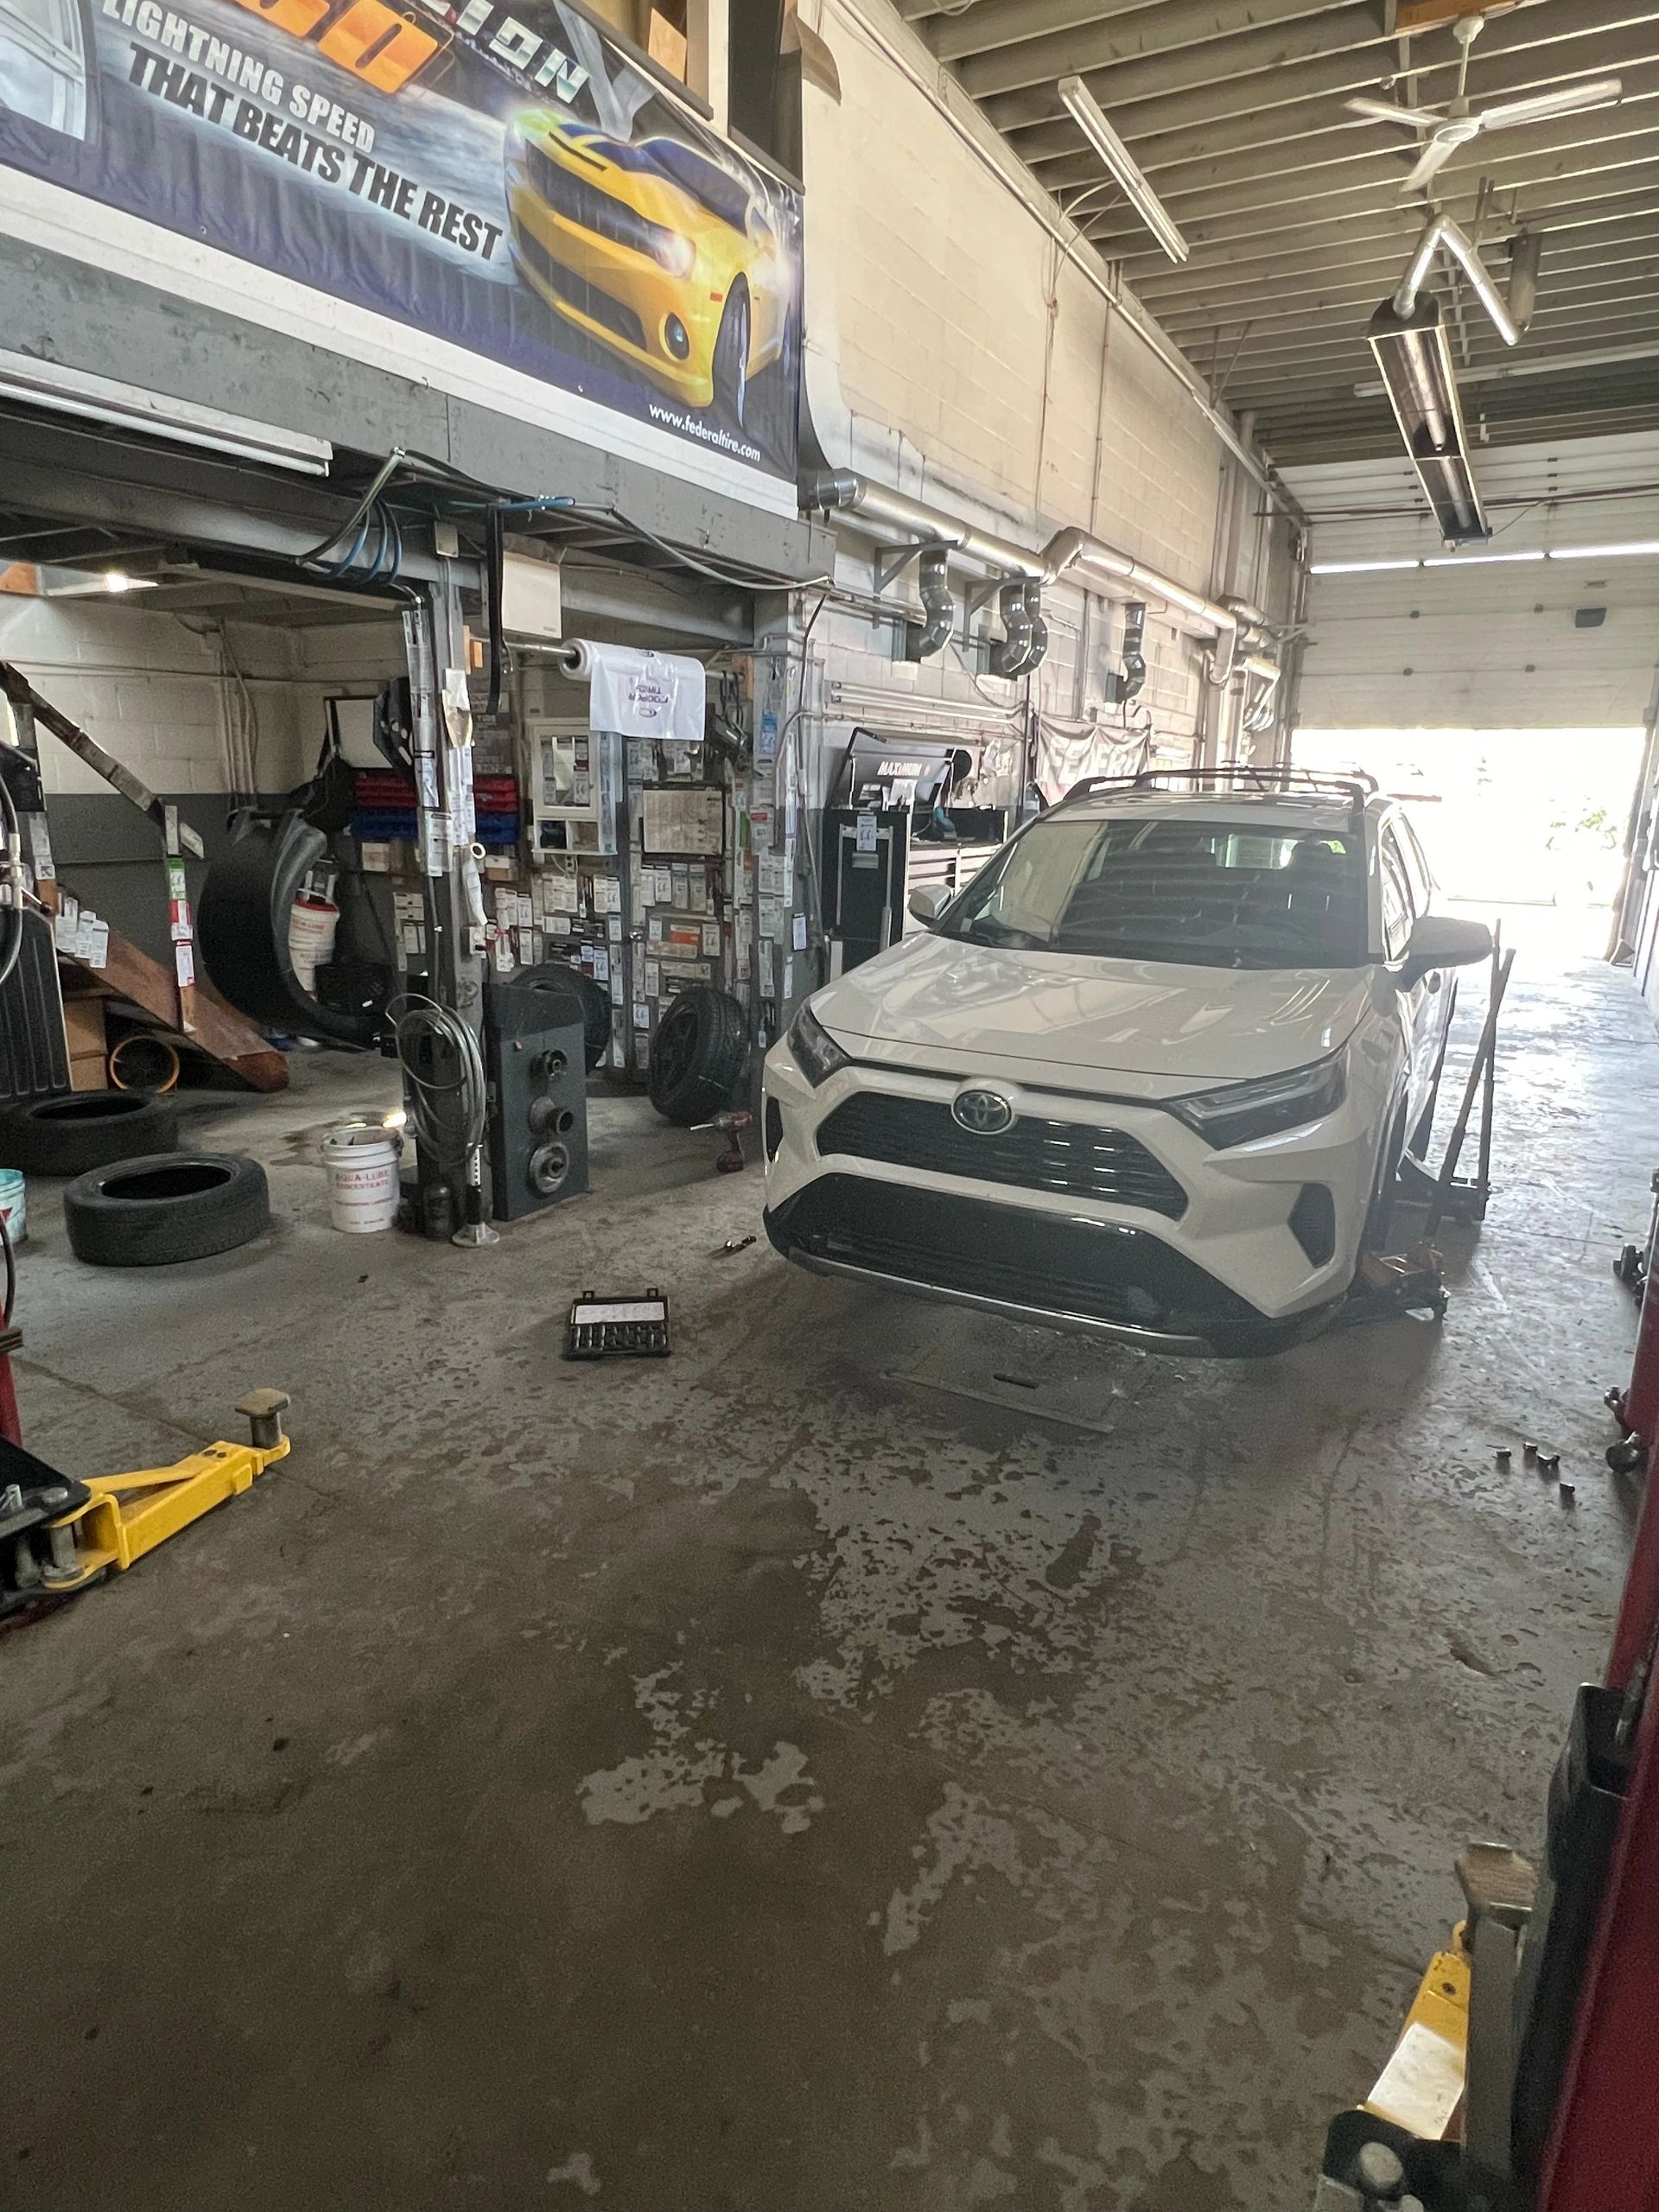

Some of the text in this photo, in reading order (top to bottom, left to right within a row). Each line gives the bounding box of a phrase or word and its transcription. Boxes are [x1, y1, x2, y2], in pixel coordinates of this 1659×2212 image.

[102, 0, 375, 154] LIGHTNING SPEED
[129, 42, 503, 261] THAT BEATS THE REST
[649, 404, 761, 461] www.federaltire.com
[877, 761, 922, 777] MAXIMUM
[335, 1170, 389, 1182] AQUA-LUBE
